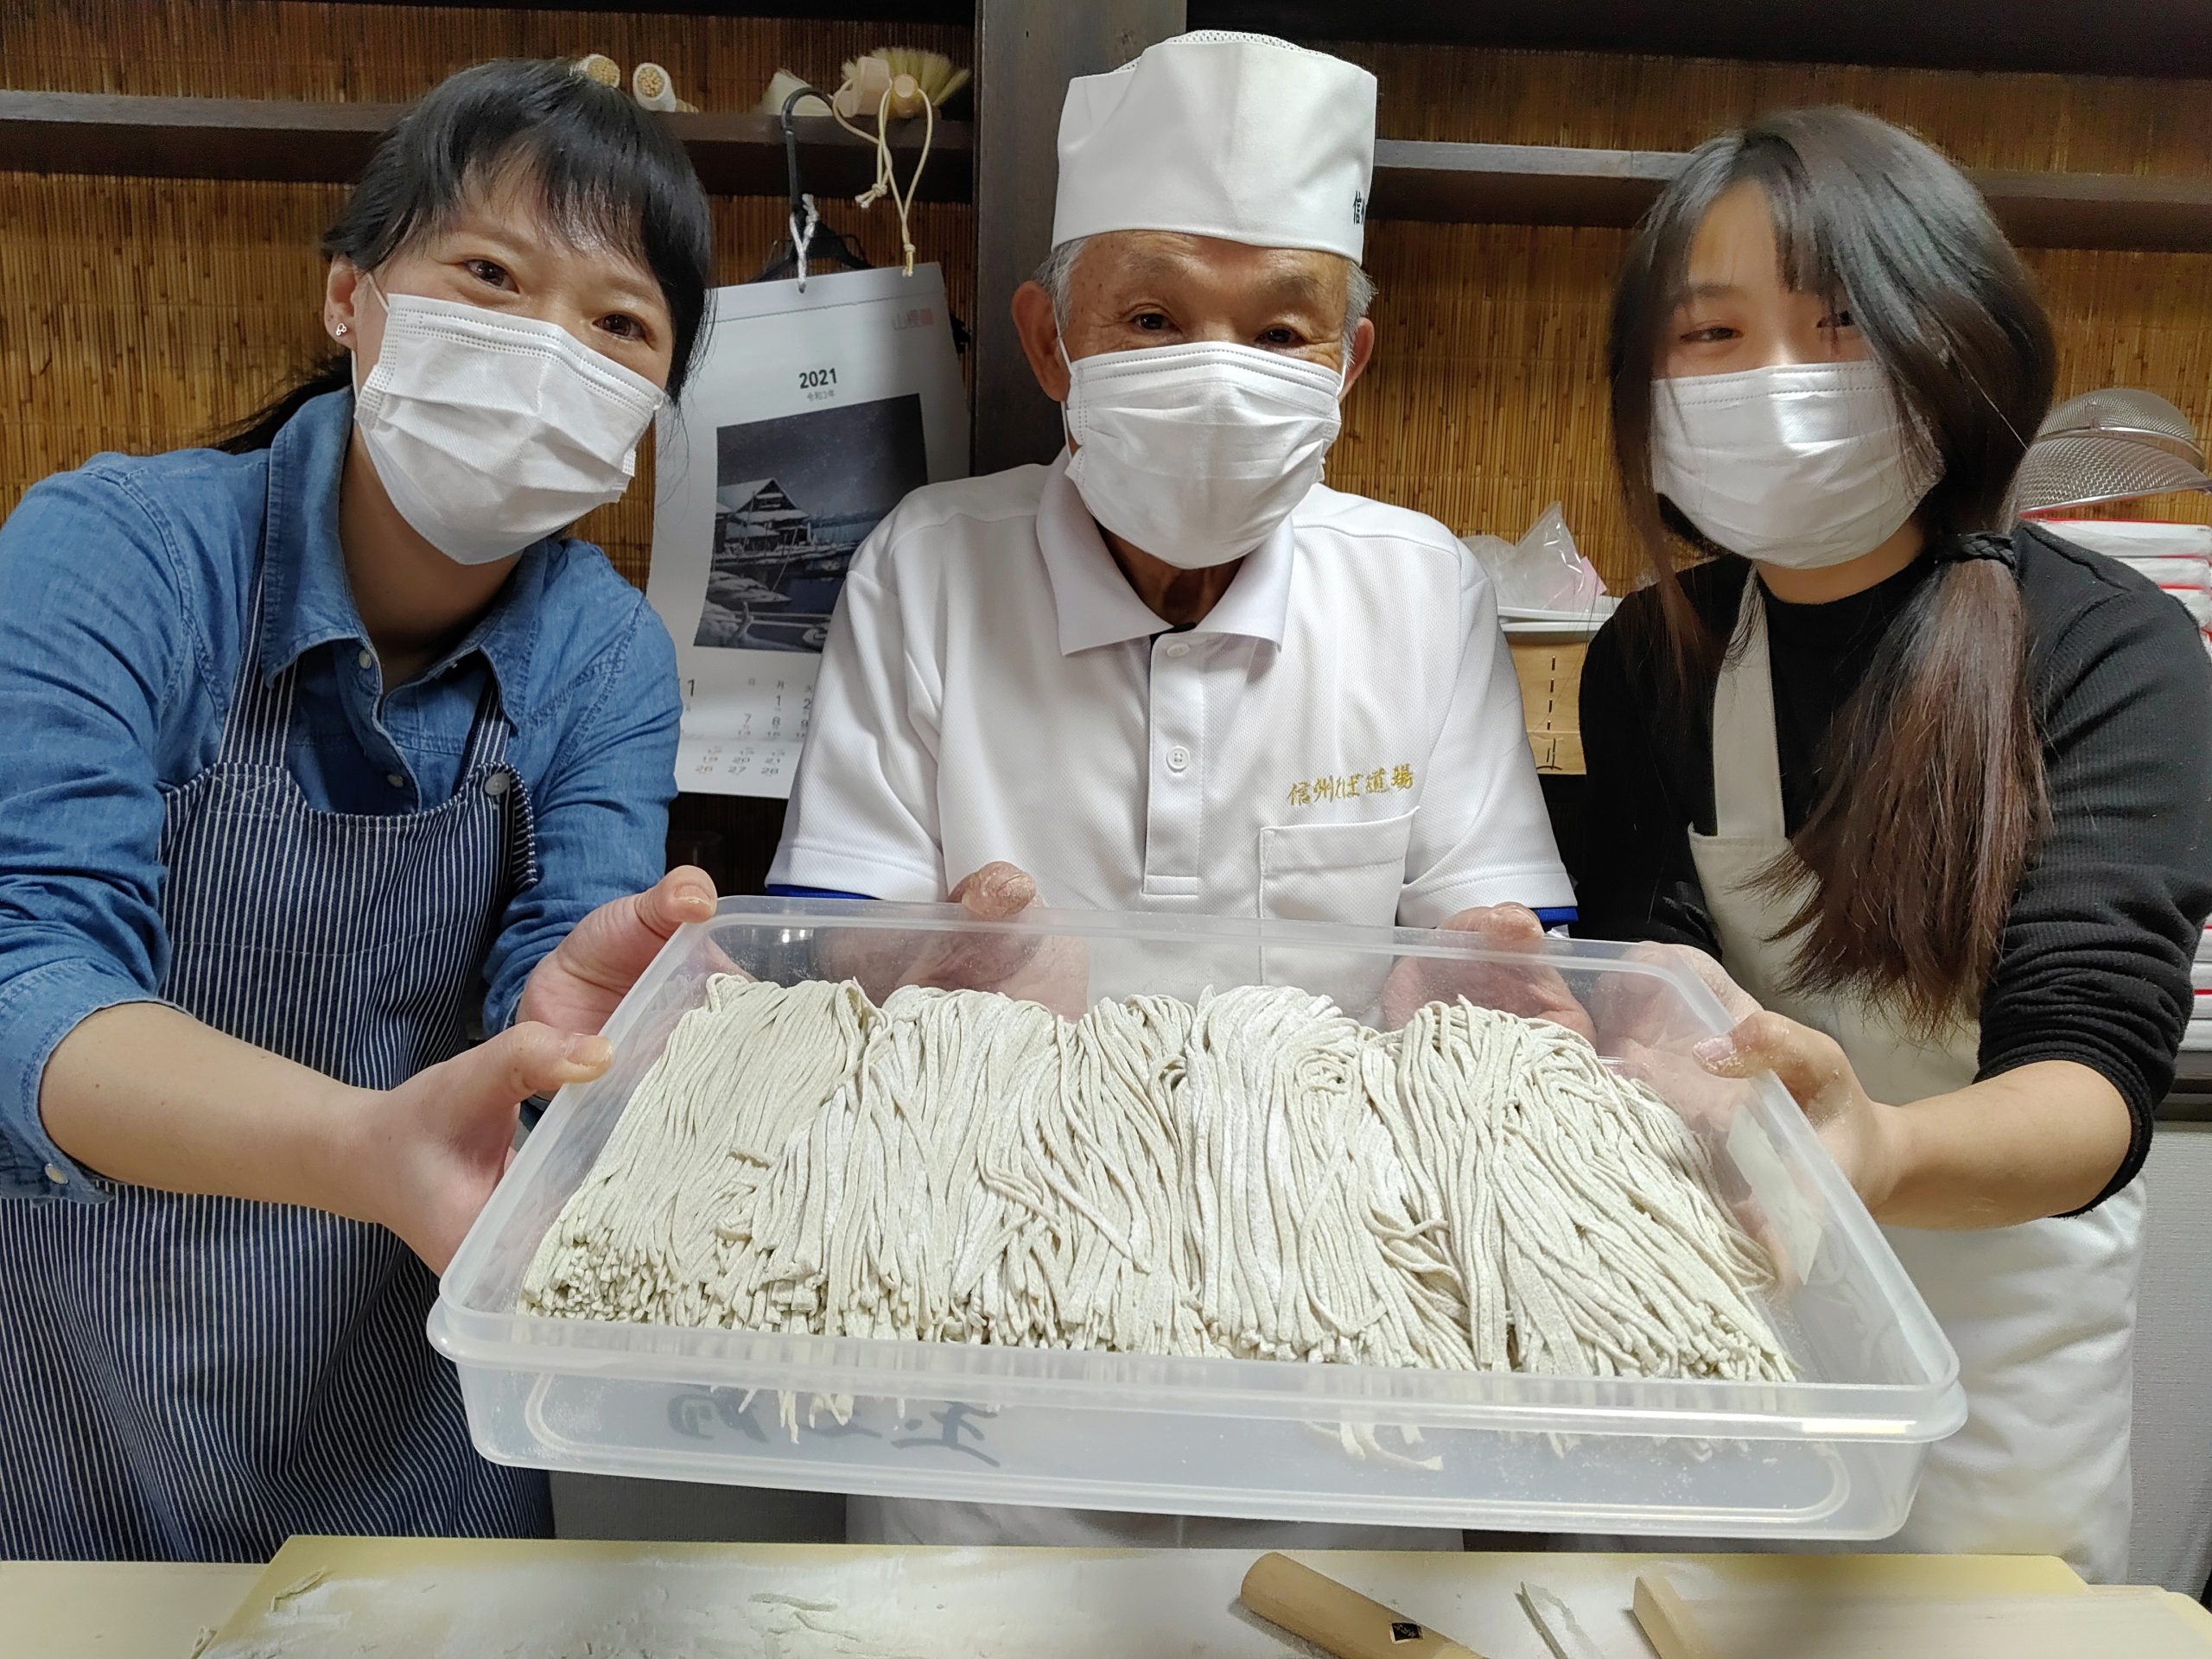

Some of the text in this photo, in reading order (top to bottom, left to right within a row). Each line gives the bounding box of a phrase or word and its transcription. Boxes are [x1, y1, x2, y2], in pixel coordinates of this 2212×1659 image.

[798, 367, 837, 390] 2021
[775, 694, 811, 709] 1 2
[744, 713, 752, 724] 7
